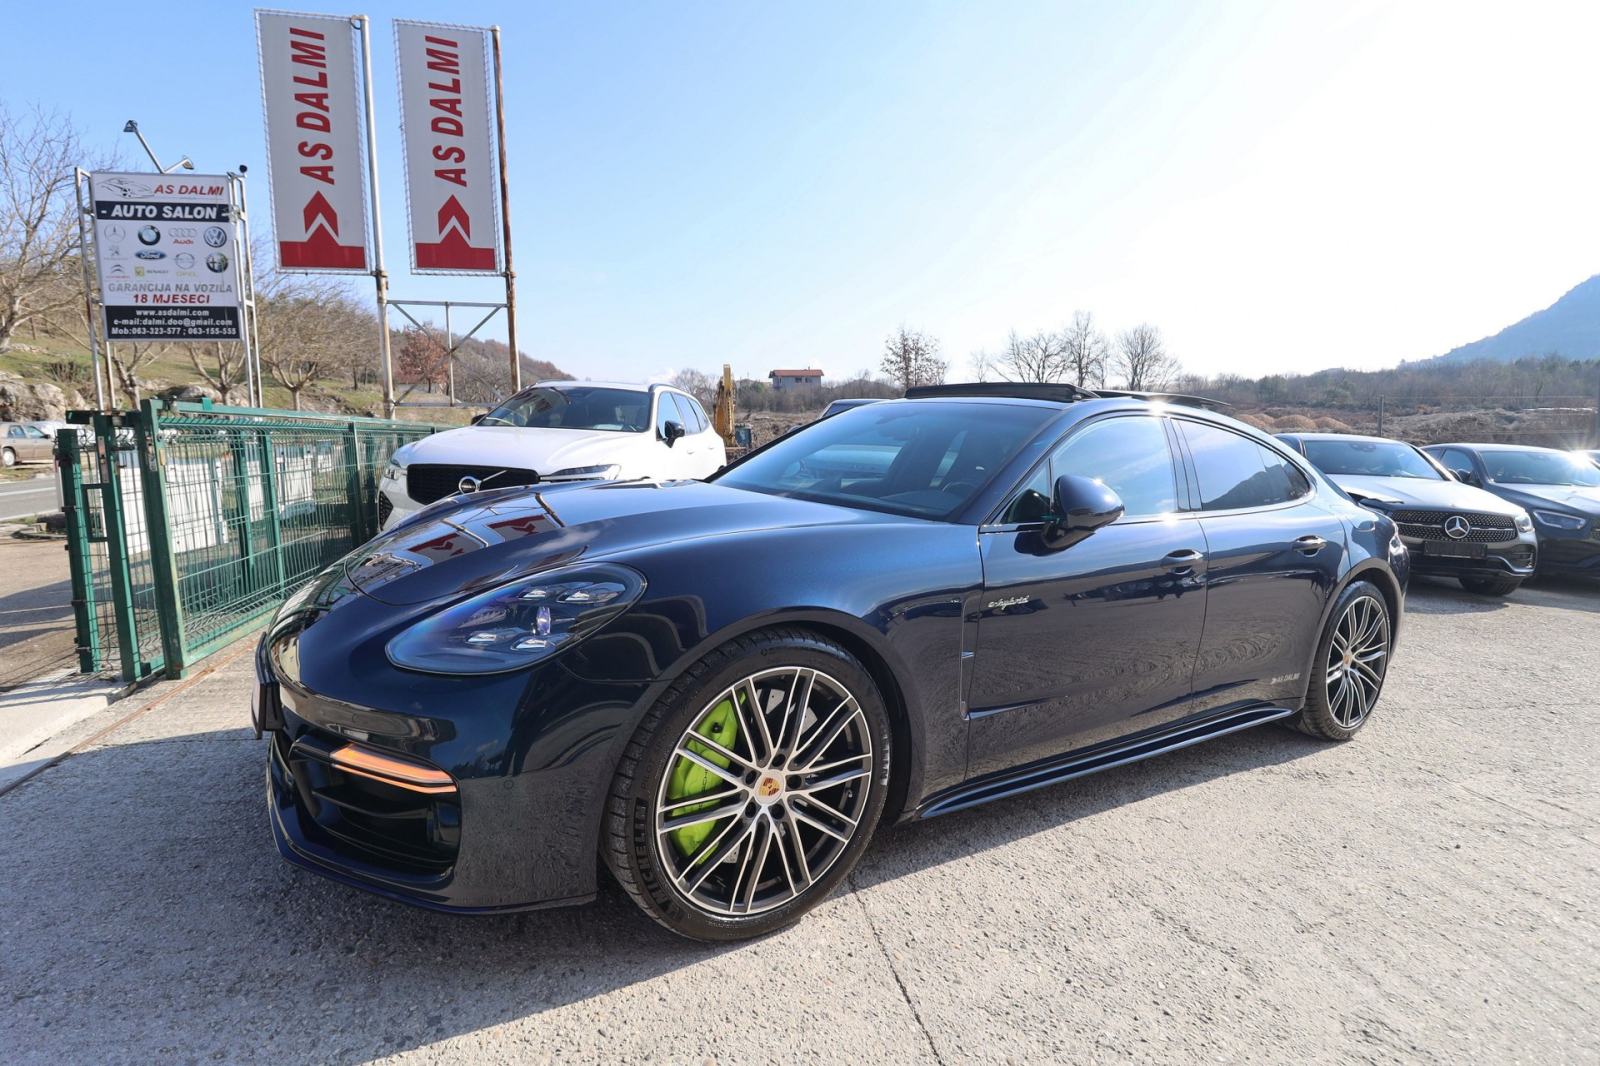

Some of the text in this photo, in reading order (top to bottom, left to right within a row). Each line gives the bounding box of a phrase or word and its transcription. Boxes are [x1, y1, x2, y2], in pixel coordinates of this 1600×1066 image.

[289, 27, 335, 185] AS DALMI
[425, 35, 467, 187] AS DALMI
[154, 184, 224, 196] AS DALMI
[111, 205, 157, 218] AUTO
[162, 206, 217, 219] SALON
[108, 283, 232, 293] GARANCIJA NA VOZILA
[133, 294, 210, 303] 18 MJESECI
